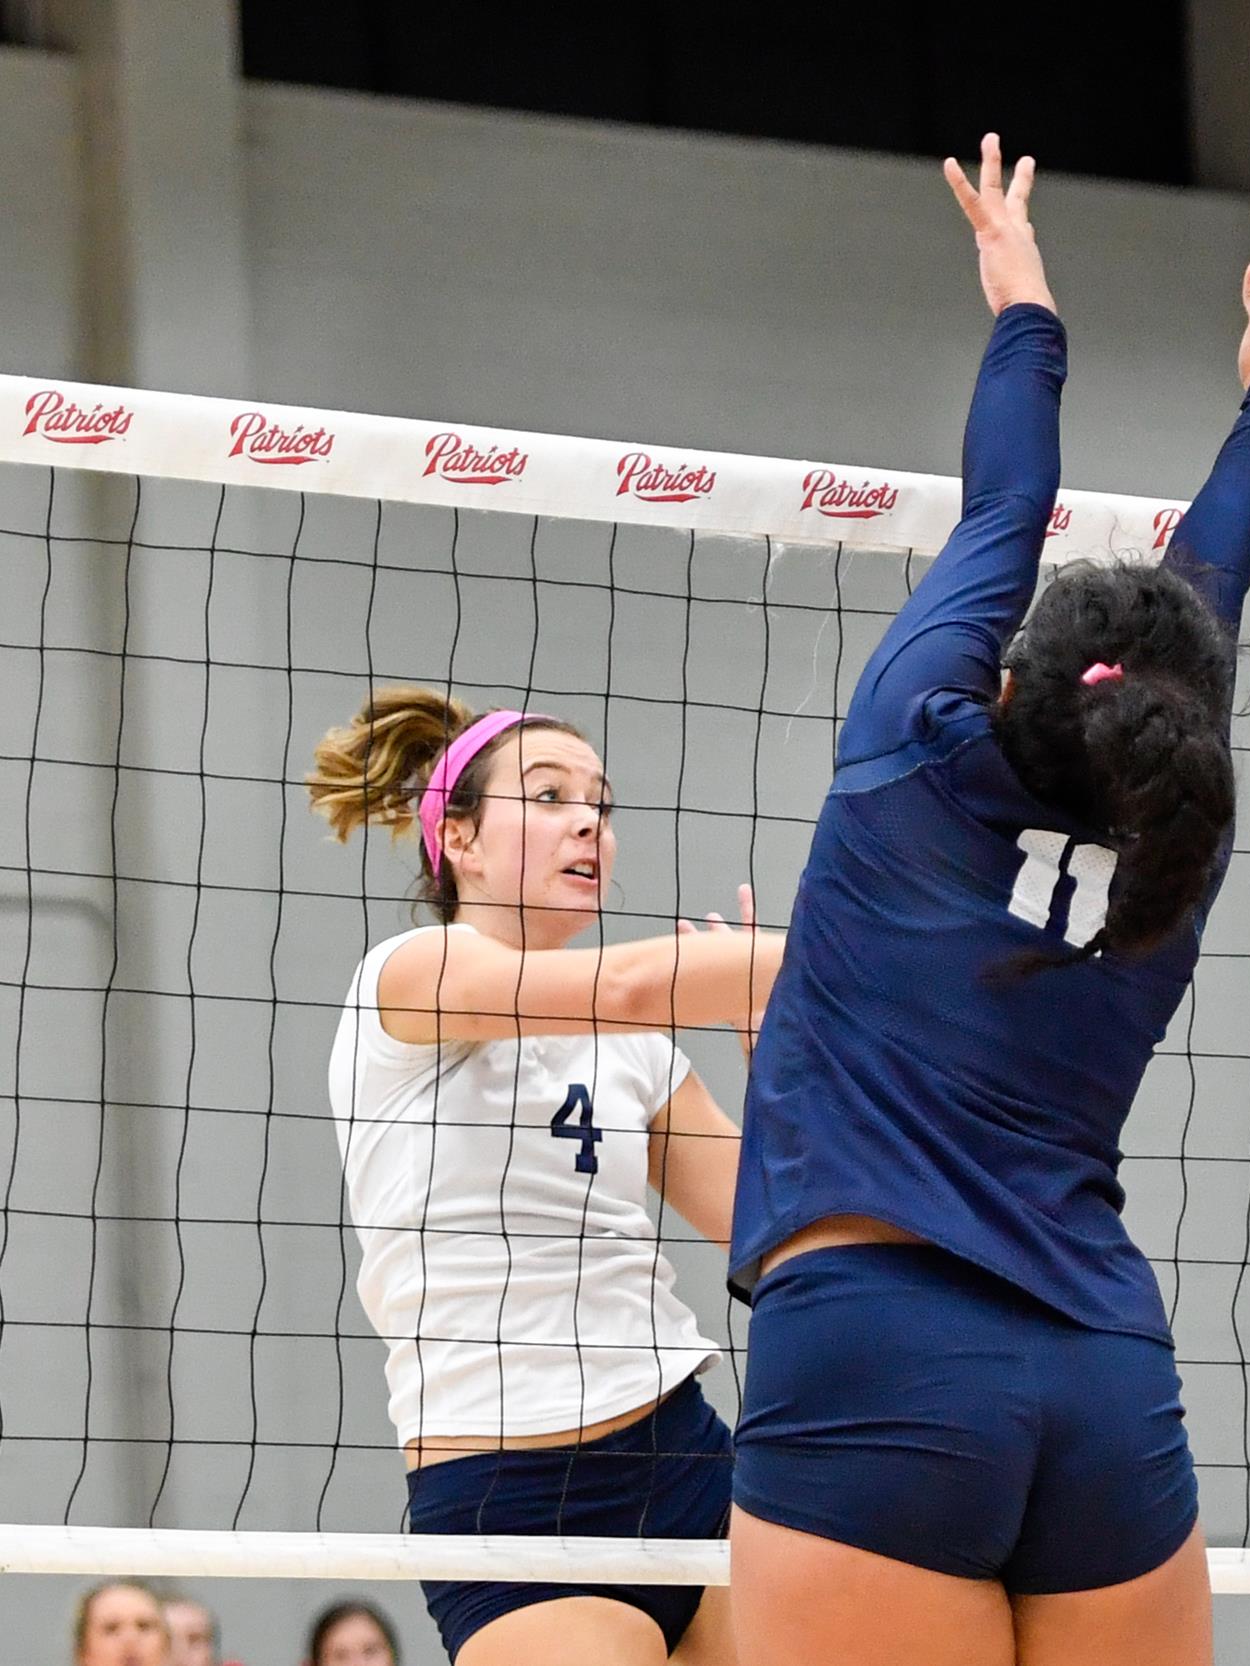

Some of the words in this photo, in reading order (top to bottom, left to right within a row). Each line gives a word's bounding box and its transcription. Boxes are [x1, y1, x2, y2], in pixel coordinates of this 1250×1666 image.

[23, 390, 134, 441] Patriots
[228, 412, 335, 462] Patriots
[423, 433, 529, 482] Patriots
[615, 452, 715, 501] Patriots
[802, 469, 897, 517] Patriots
[1008, 828, 1119, 957] 11
[551, 1084, 602, 1174] 4
